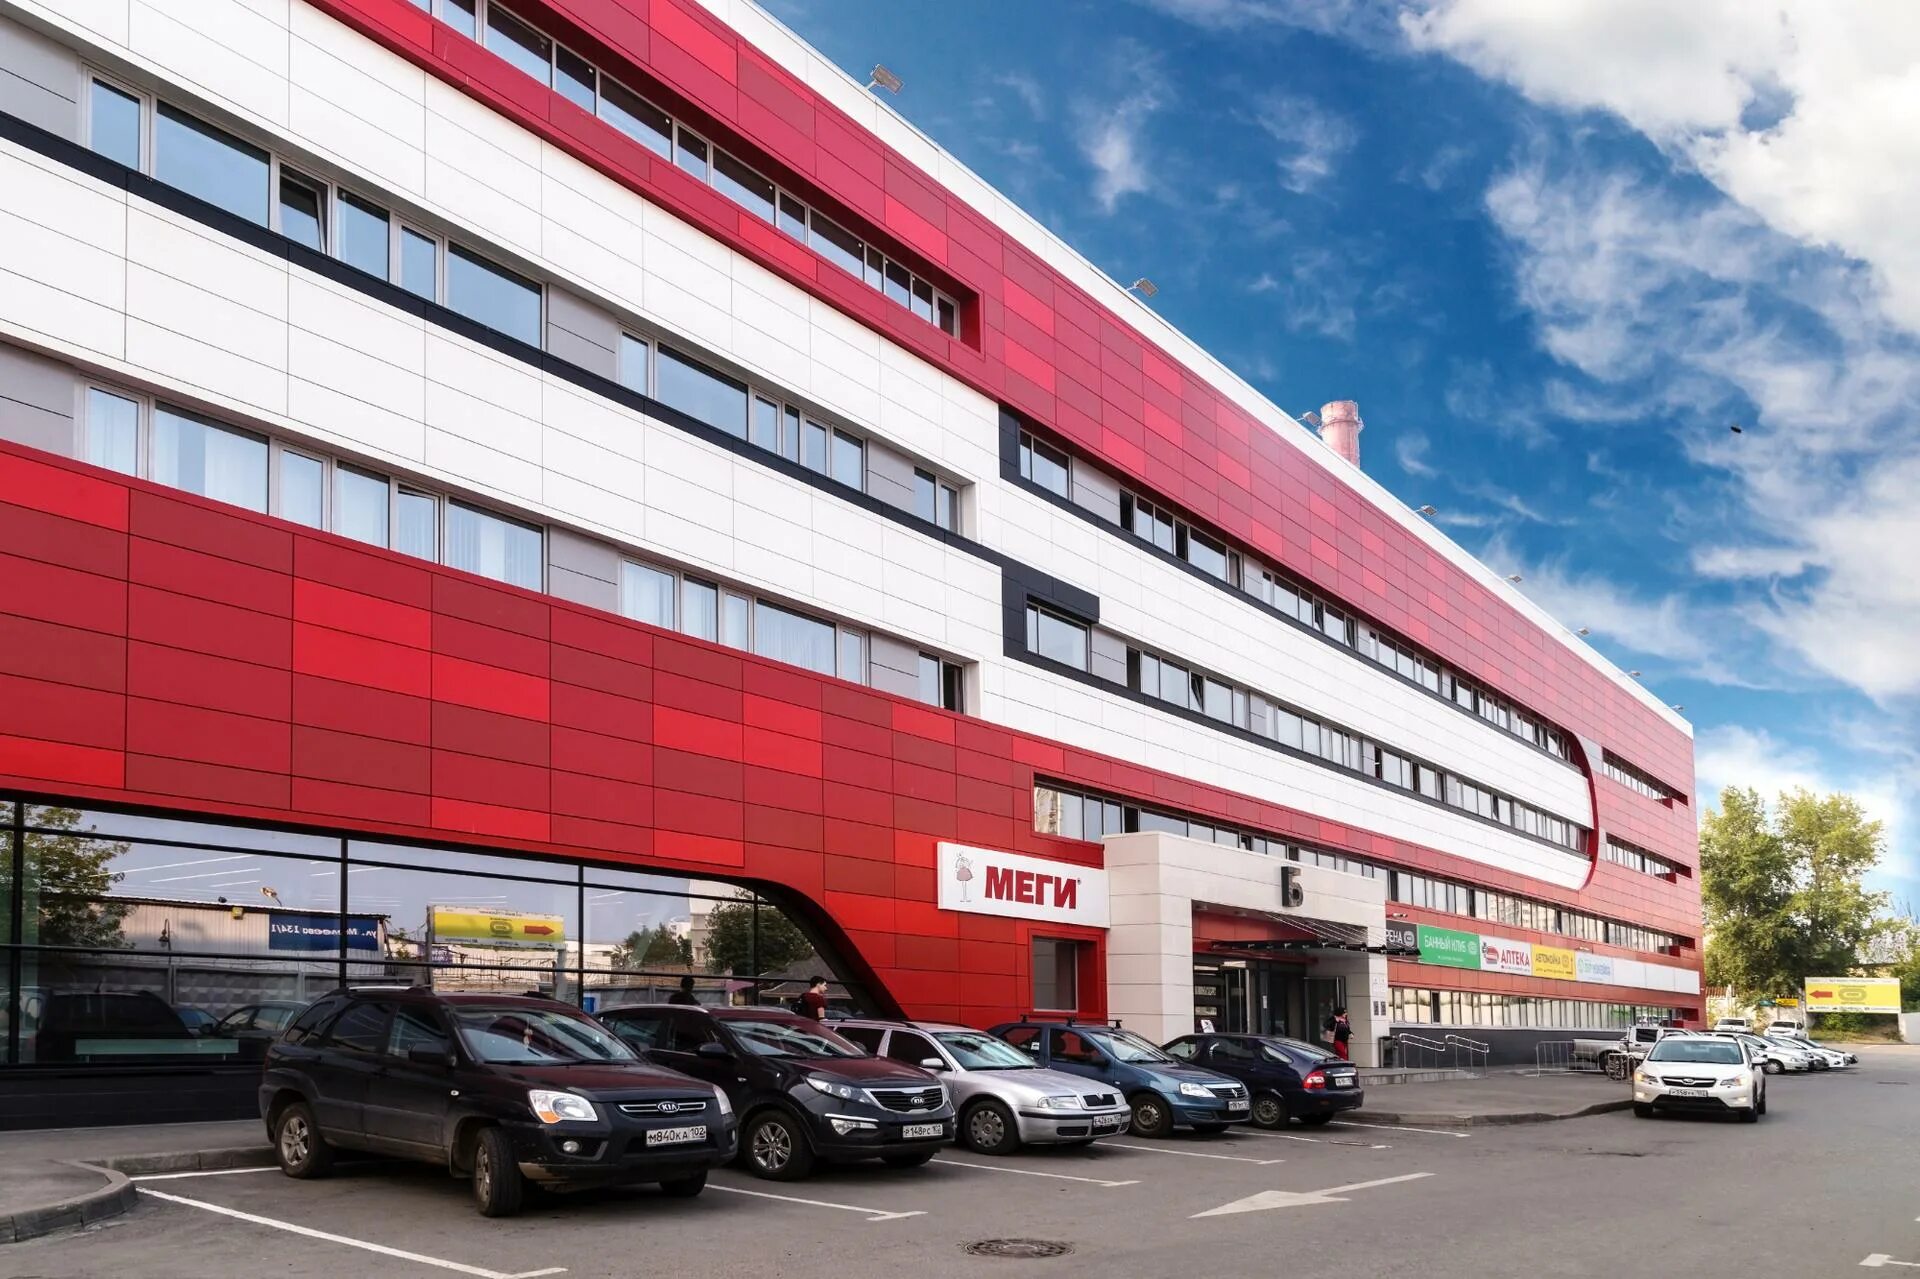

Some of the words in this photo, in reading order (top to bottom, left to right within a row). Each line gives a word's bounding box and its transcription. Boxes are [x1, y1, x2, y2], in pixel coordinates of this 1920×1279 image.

[985, 866, 1076, 909] МЕГИ
[1281, 866, 1303, 907] Б
[1385, 929, 1404, 945] РЕНА
[1424, 935, 1450, 951] БАННЫЙ
[1501, 949, 1530, 967] АПТЕКА
